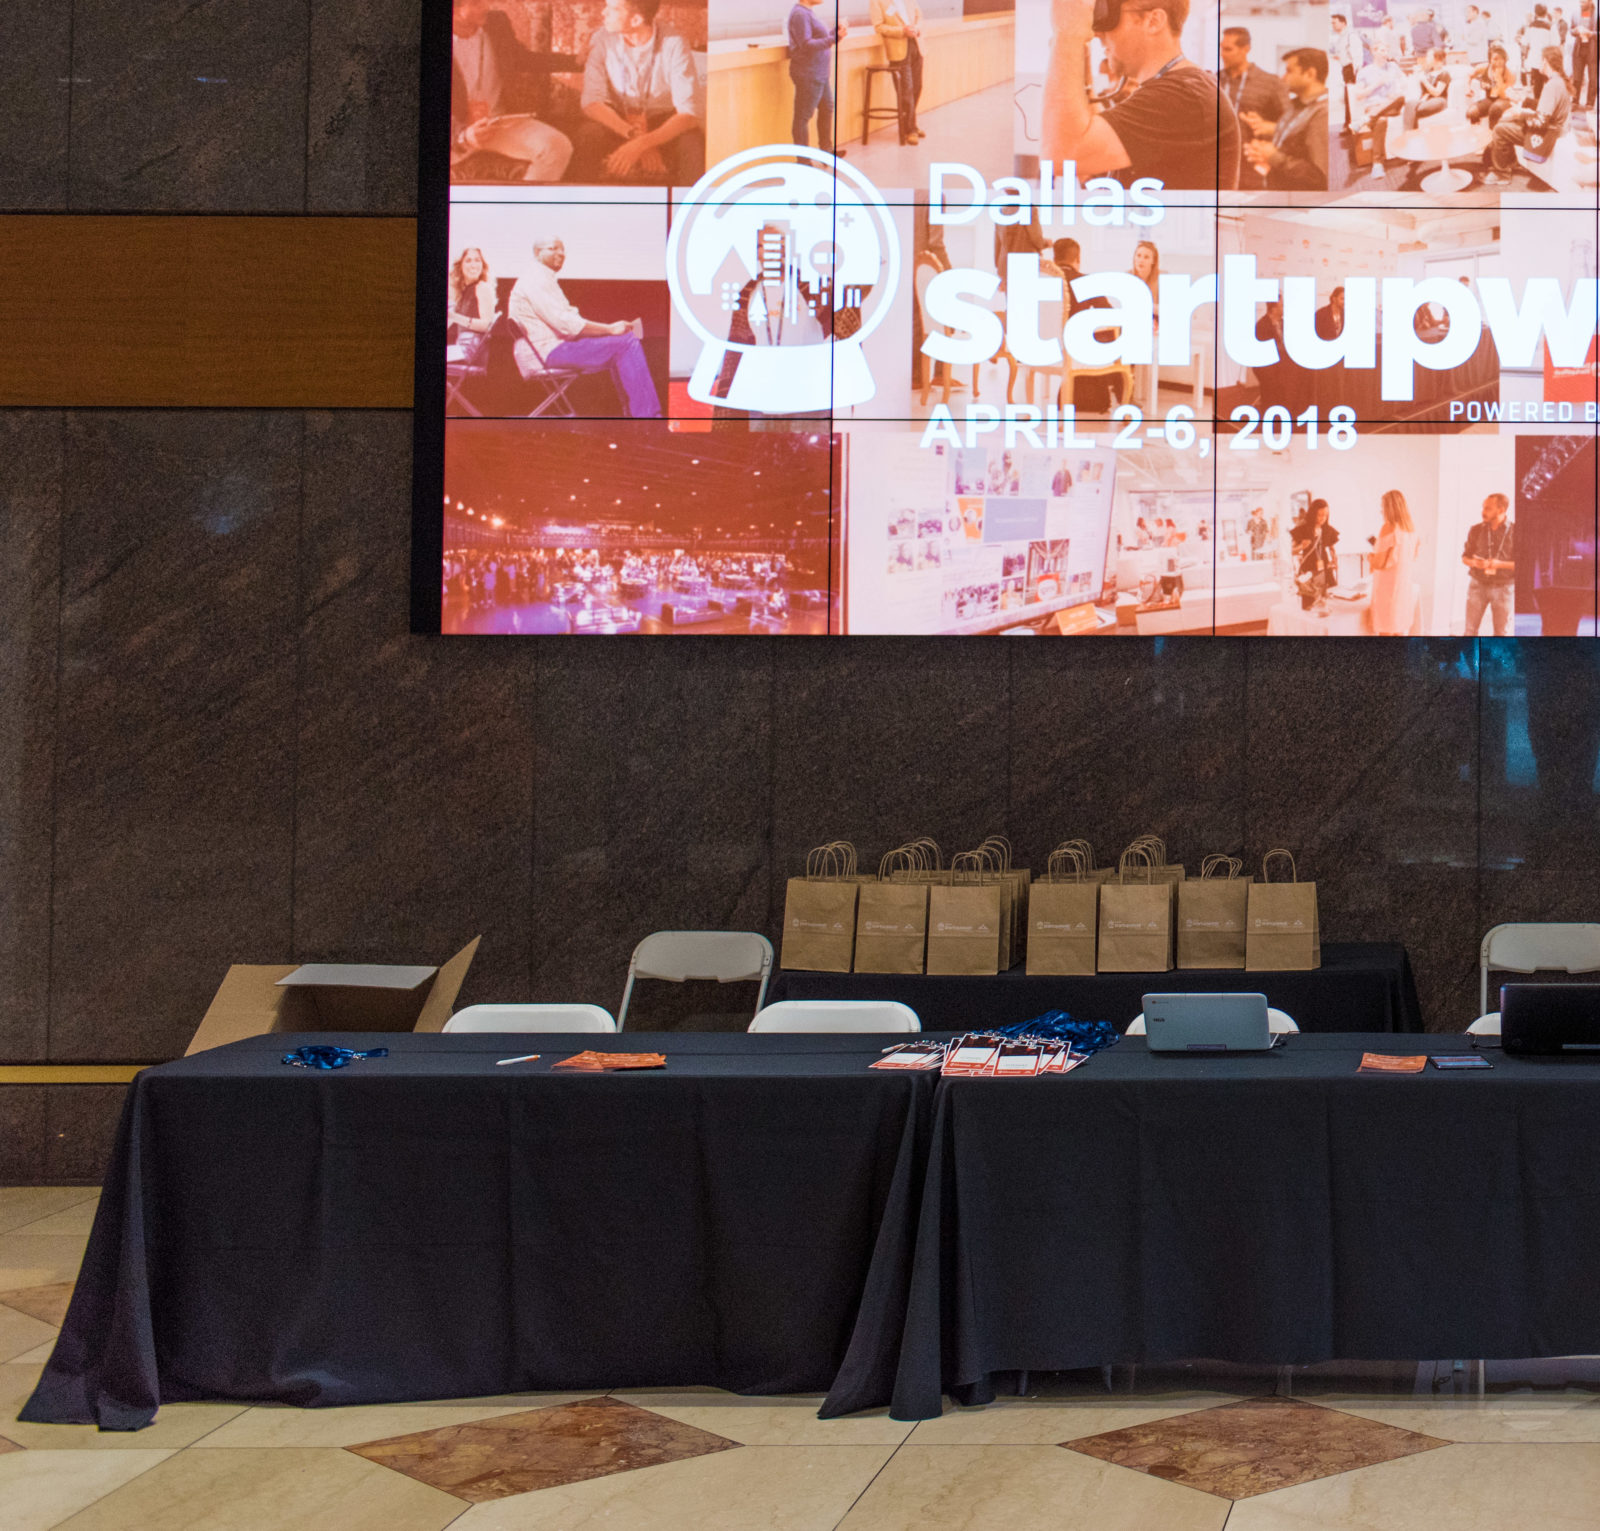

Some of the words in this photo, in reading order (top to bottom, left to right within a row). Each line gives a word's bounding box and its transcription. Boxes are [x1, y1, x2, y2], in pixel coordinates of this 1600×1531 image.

[929, 160, 1165, 227] Dallas
[919, 403, 1096, 449] APRIL
[1111, 405, 1210, 458] 2-6,
[1229, 405, 1357, 451] 2018
[1450, 401, 1573, 422] POWERED
